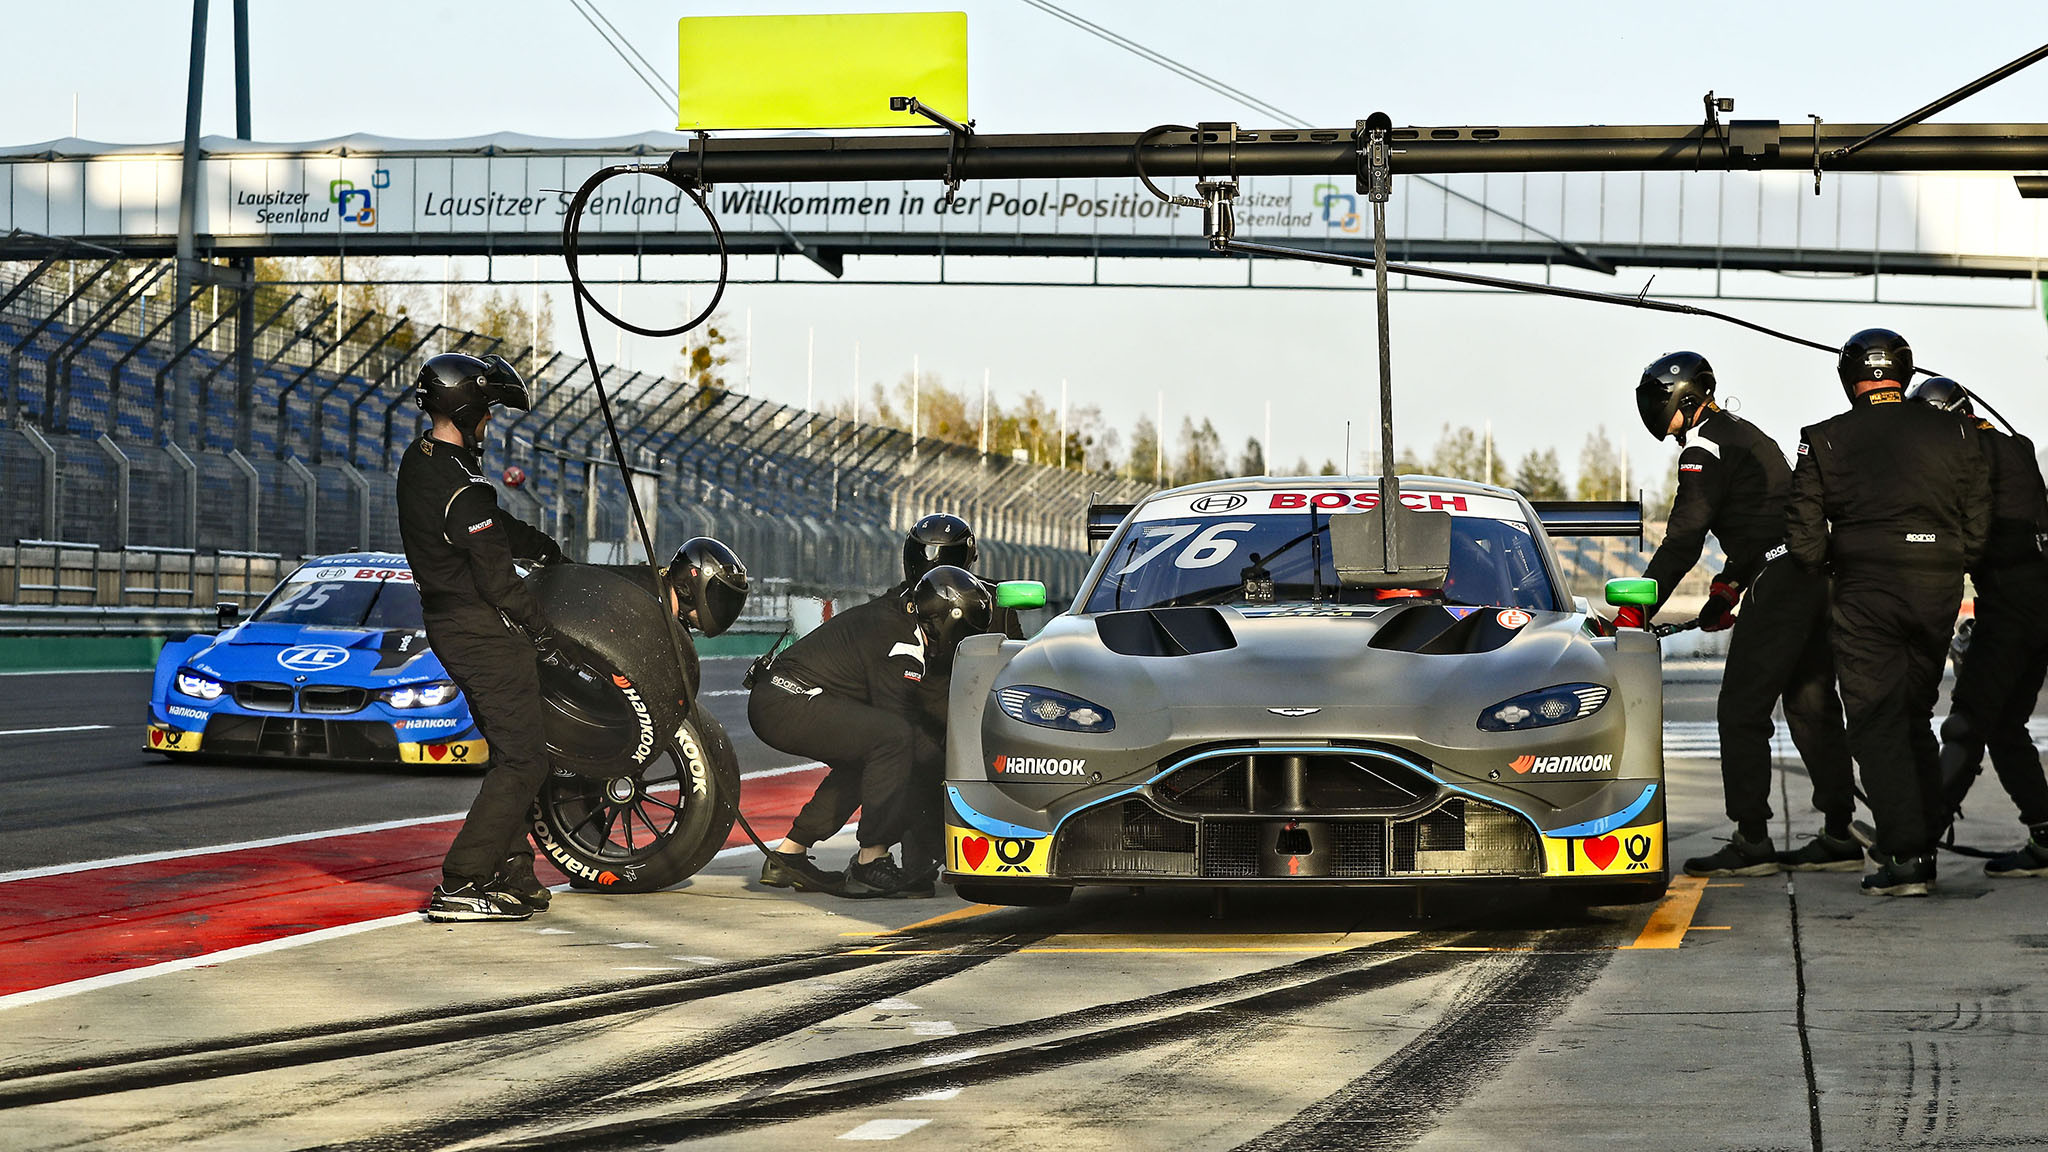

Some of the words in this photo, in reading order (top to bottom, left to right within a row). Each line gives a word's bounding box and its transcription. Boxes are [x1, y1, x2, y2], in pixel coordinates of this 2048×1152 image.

[238, 190, 310, 205] Lausitzer
[424, 191, 546, 216] Lausitzer
[555, 191, 682, 216] Senland
[721, 190, 890, 215] Willkommen
[900, 190, 924, 215] in
[933, 192, 981, 215] der
[256, 208, 330, 224] Seenland
[1236, 210, 1312, 227] Seenland
[1116, 522, 1256, 576] 76
[266, 584, 345, 613] 25
[285, 649, 338, 667] ZF
